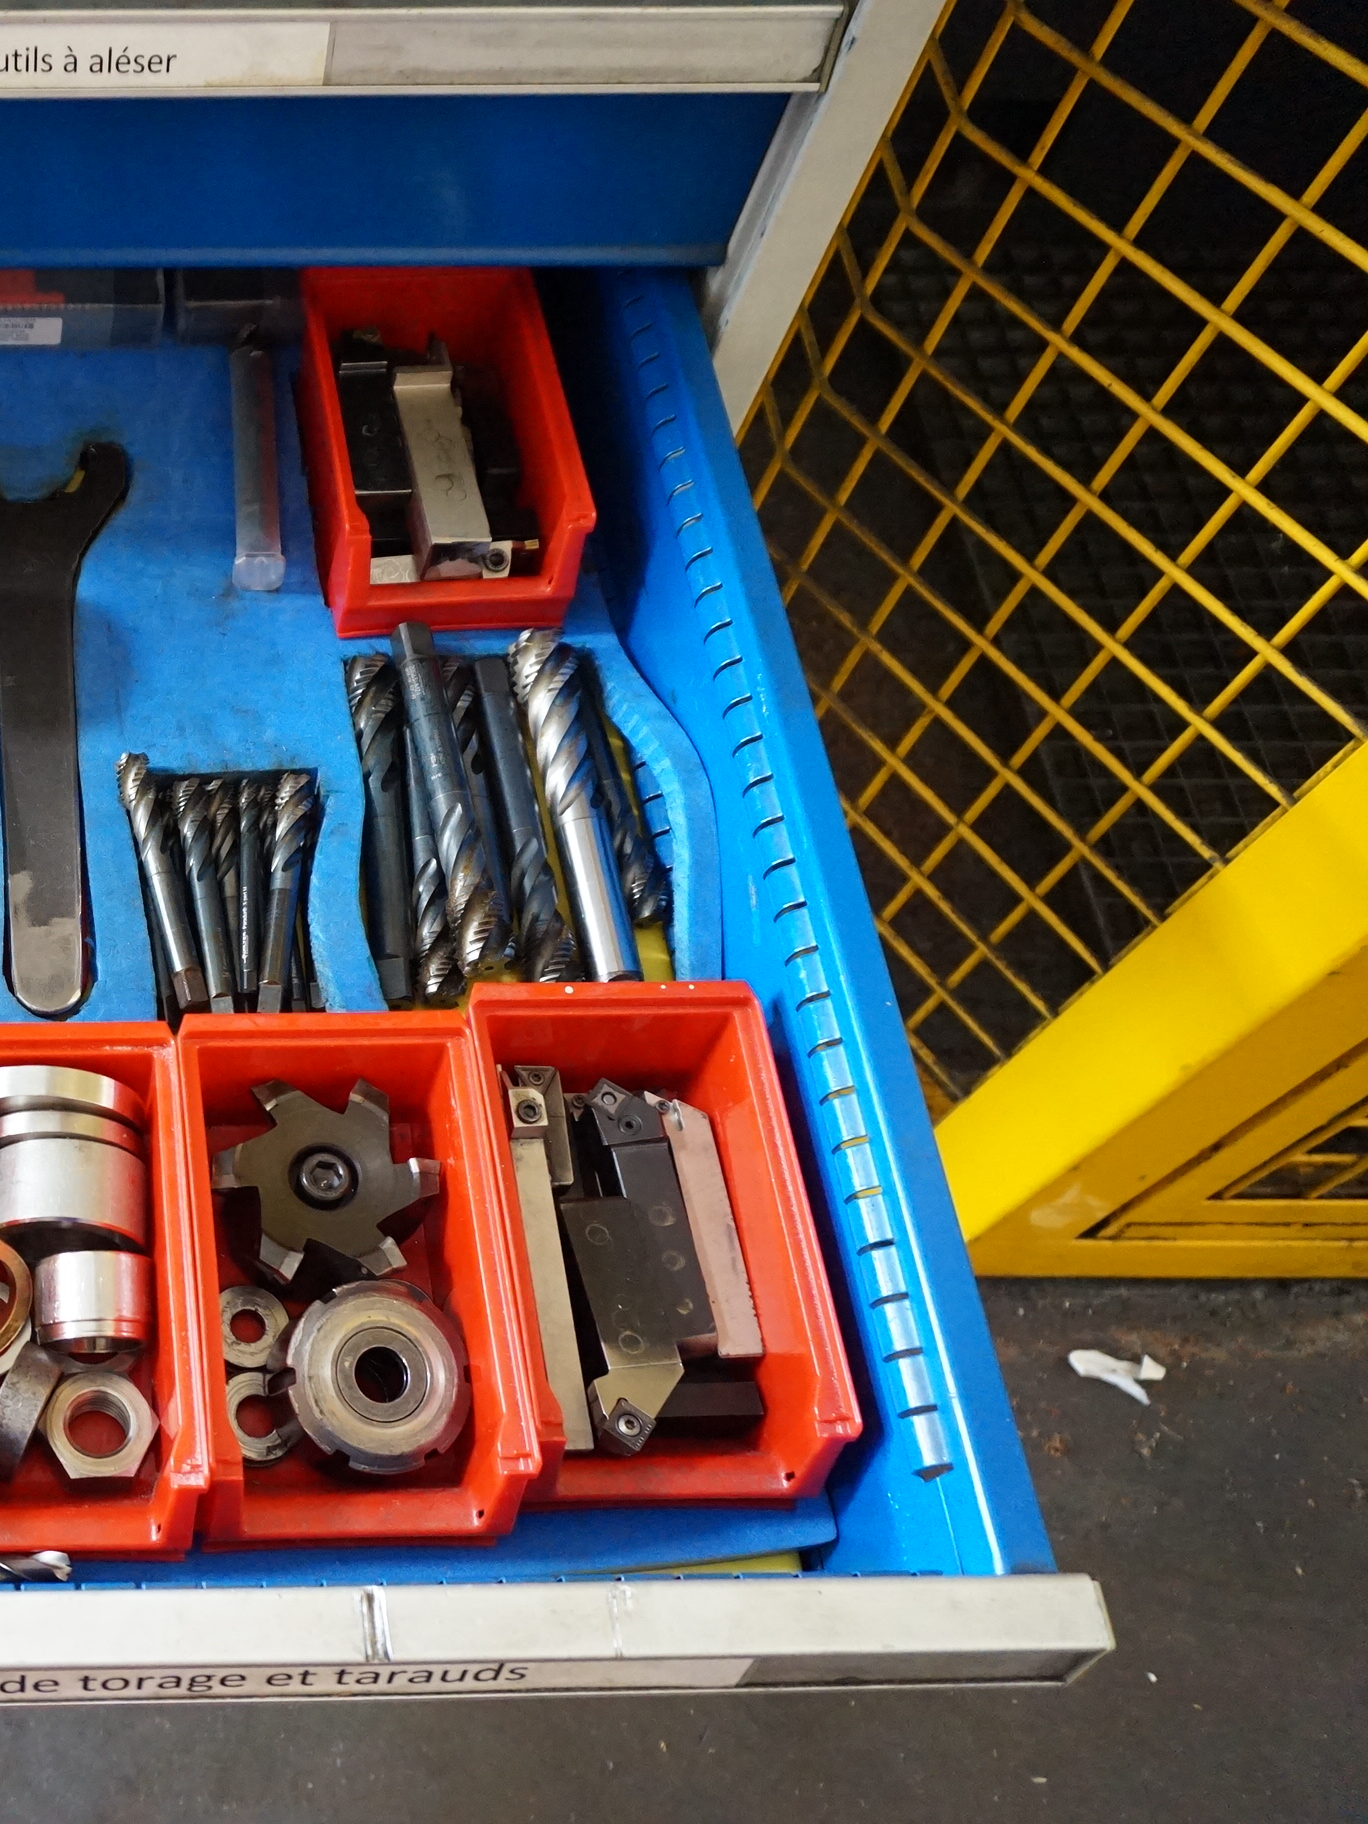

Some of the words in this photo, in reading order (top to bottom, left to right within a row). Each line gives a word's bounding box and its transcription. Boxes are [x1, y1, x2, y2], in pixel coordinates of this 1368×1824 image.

[63, 46, 78, 73] à
[89, 46, 178, 73] aléser
[78, 1672, 247, 1693] torage
[265, 1669, 318, 1687] et
[333, 1662, 529, 1687] tarauds
